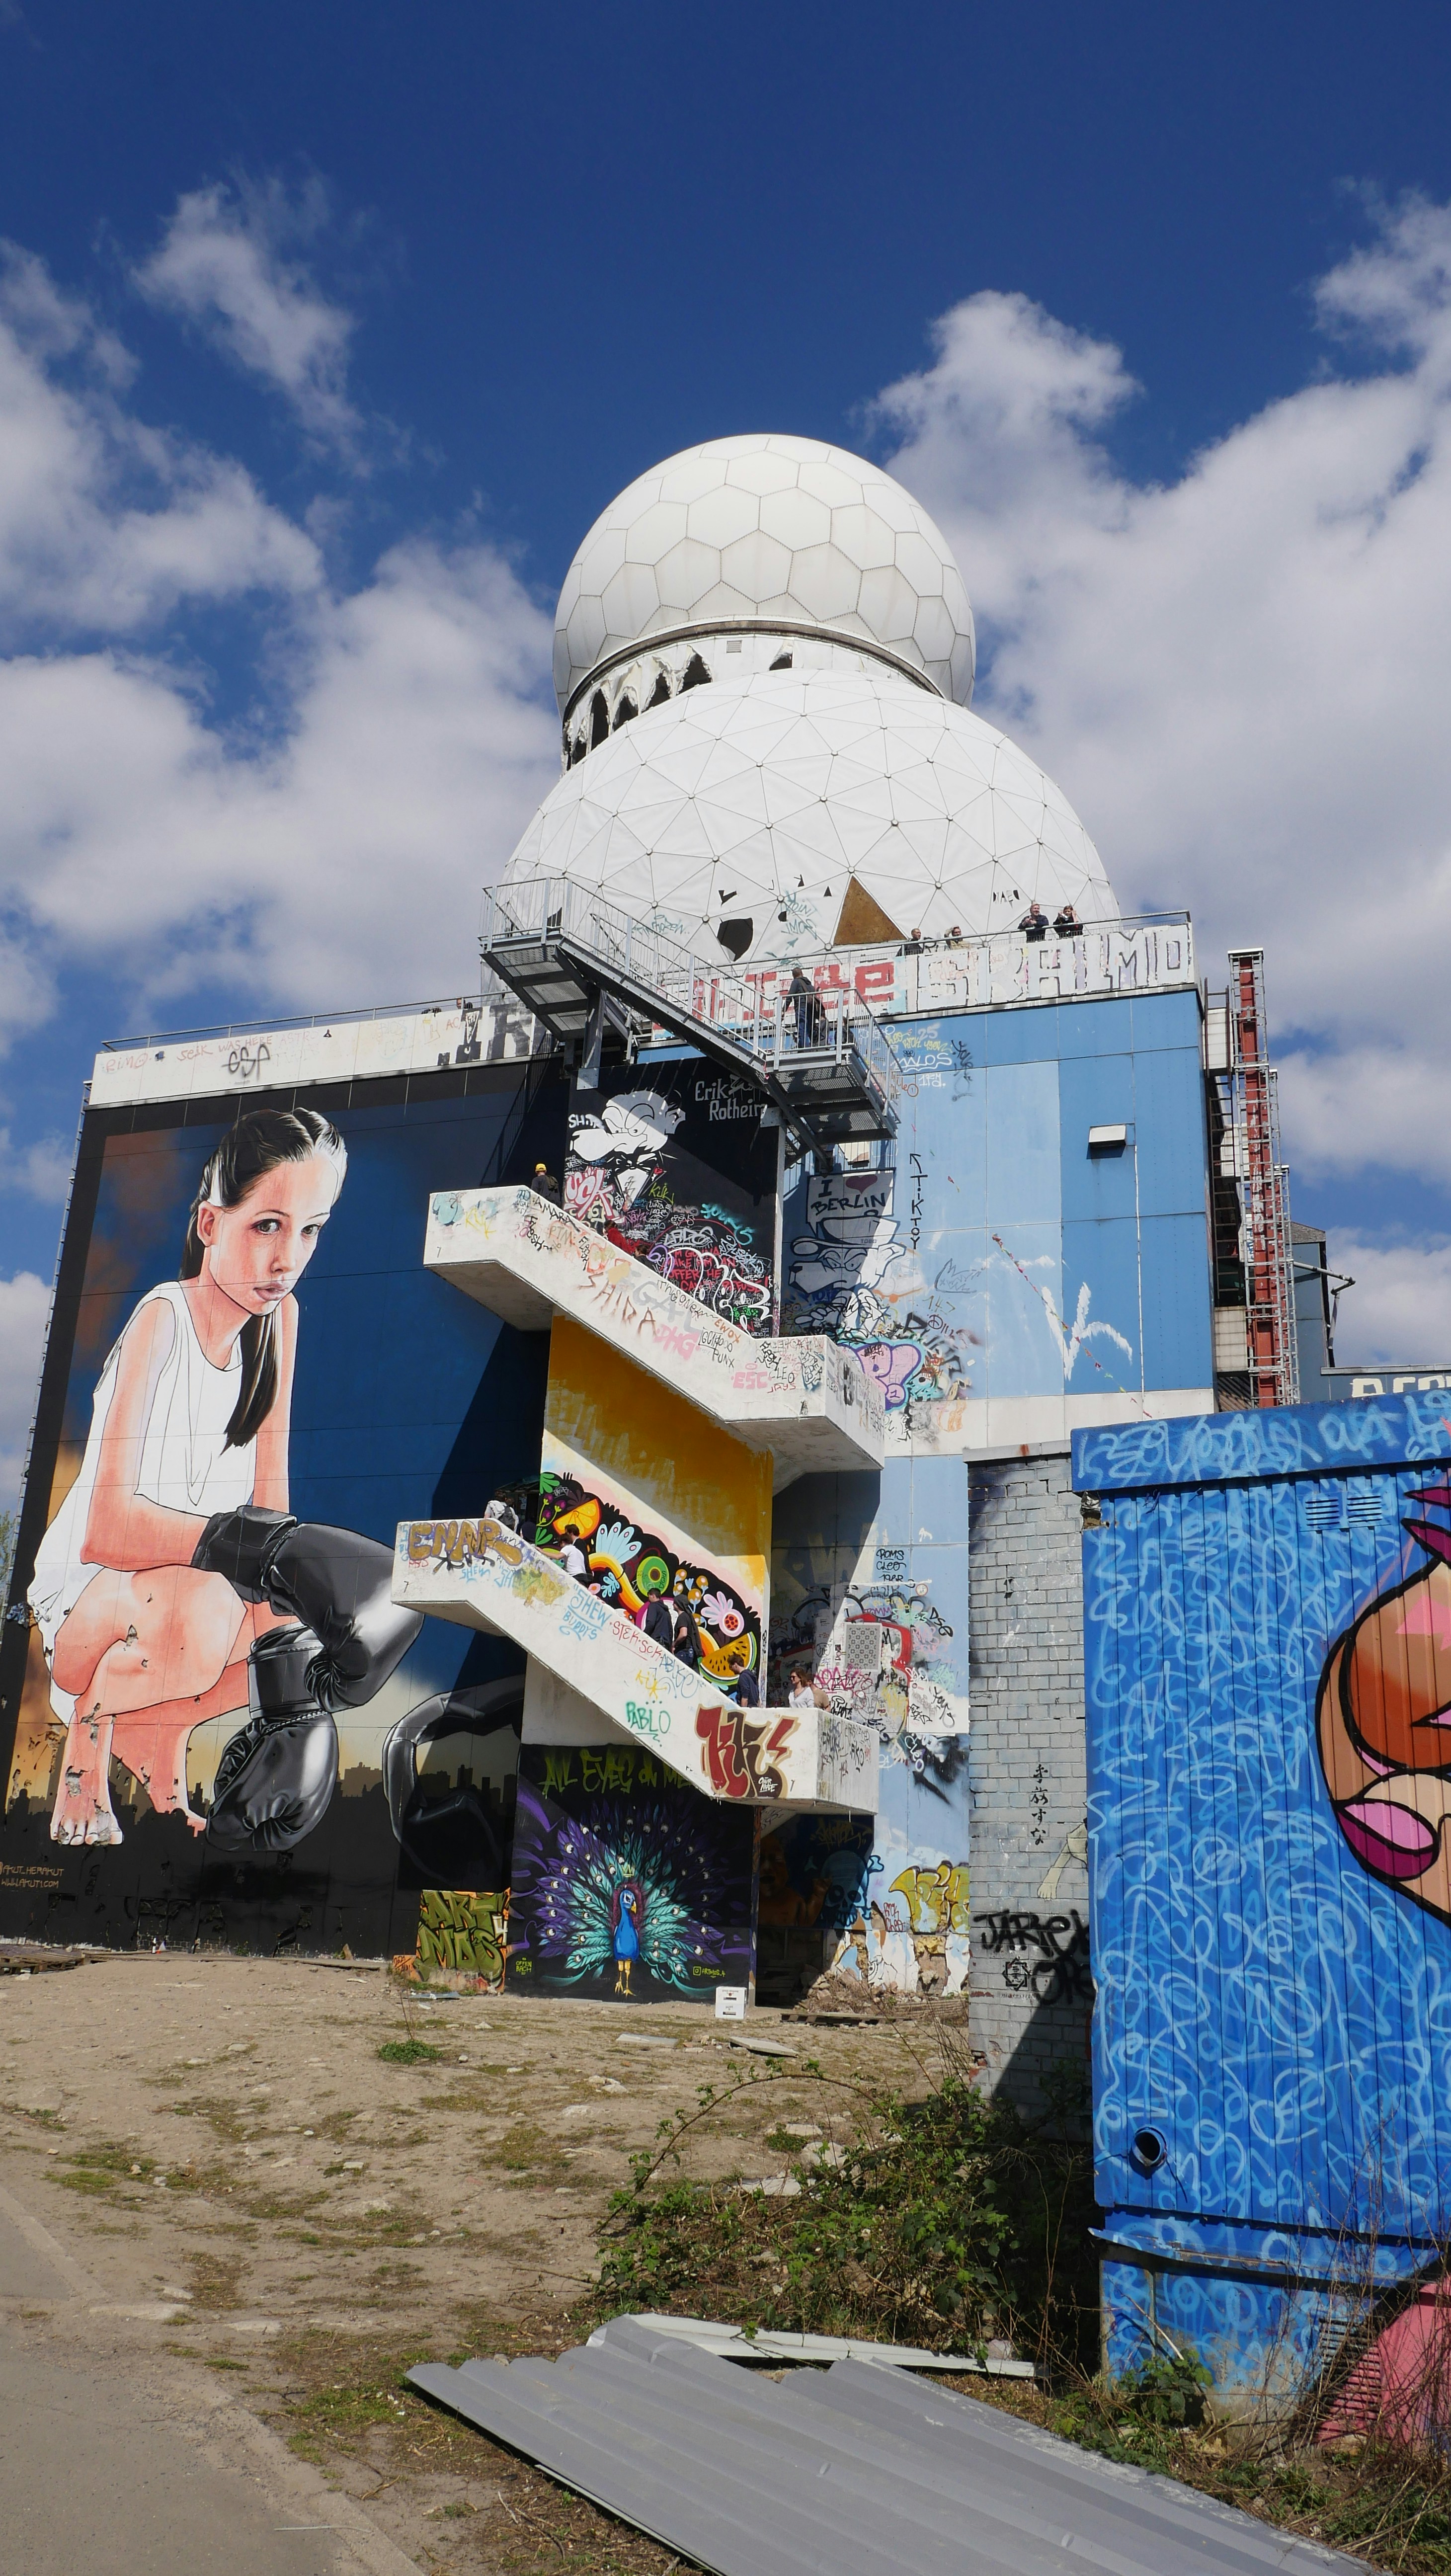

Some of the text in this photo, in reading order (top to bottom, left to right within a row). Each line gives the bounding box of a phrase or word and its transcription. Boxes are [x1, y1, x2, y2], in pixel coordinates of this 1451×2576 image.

[219, 1040, 241, 1052] WAS
[244, 1035, 273, 1049] HERE
[695, 1078, 729, 1102] Erik
[820, 1179, 833, 1198] I
[810, 1192, 886, 1215] BERLIN
[715, 1318, 741, 1344] EWOX
[769, 1367, 795, 1383] CLEO
[876, 1548, 904, 1560] ROMS
[626, 1701, 671, 1734] PABLO
[537, 1757, 578, 1799] ALL
[662, 1763, 692, 1789] ME
